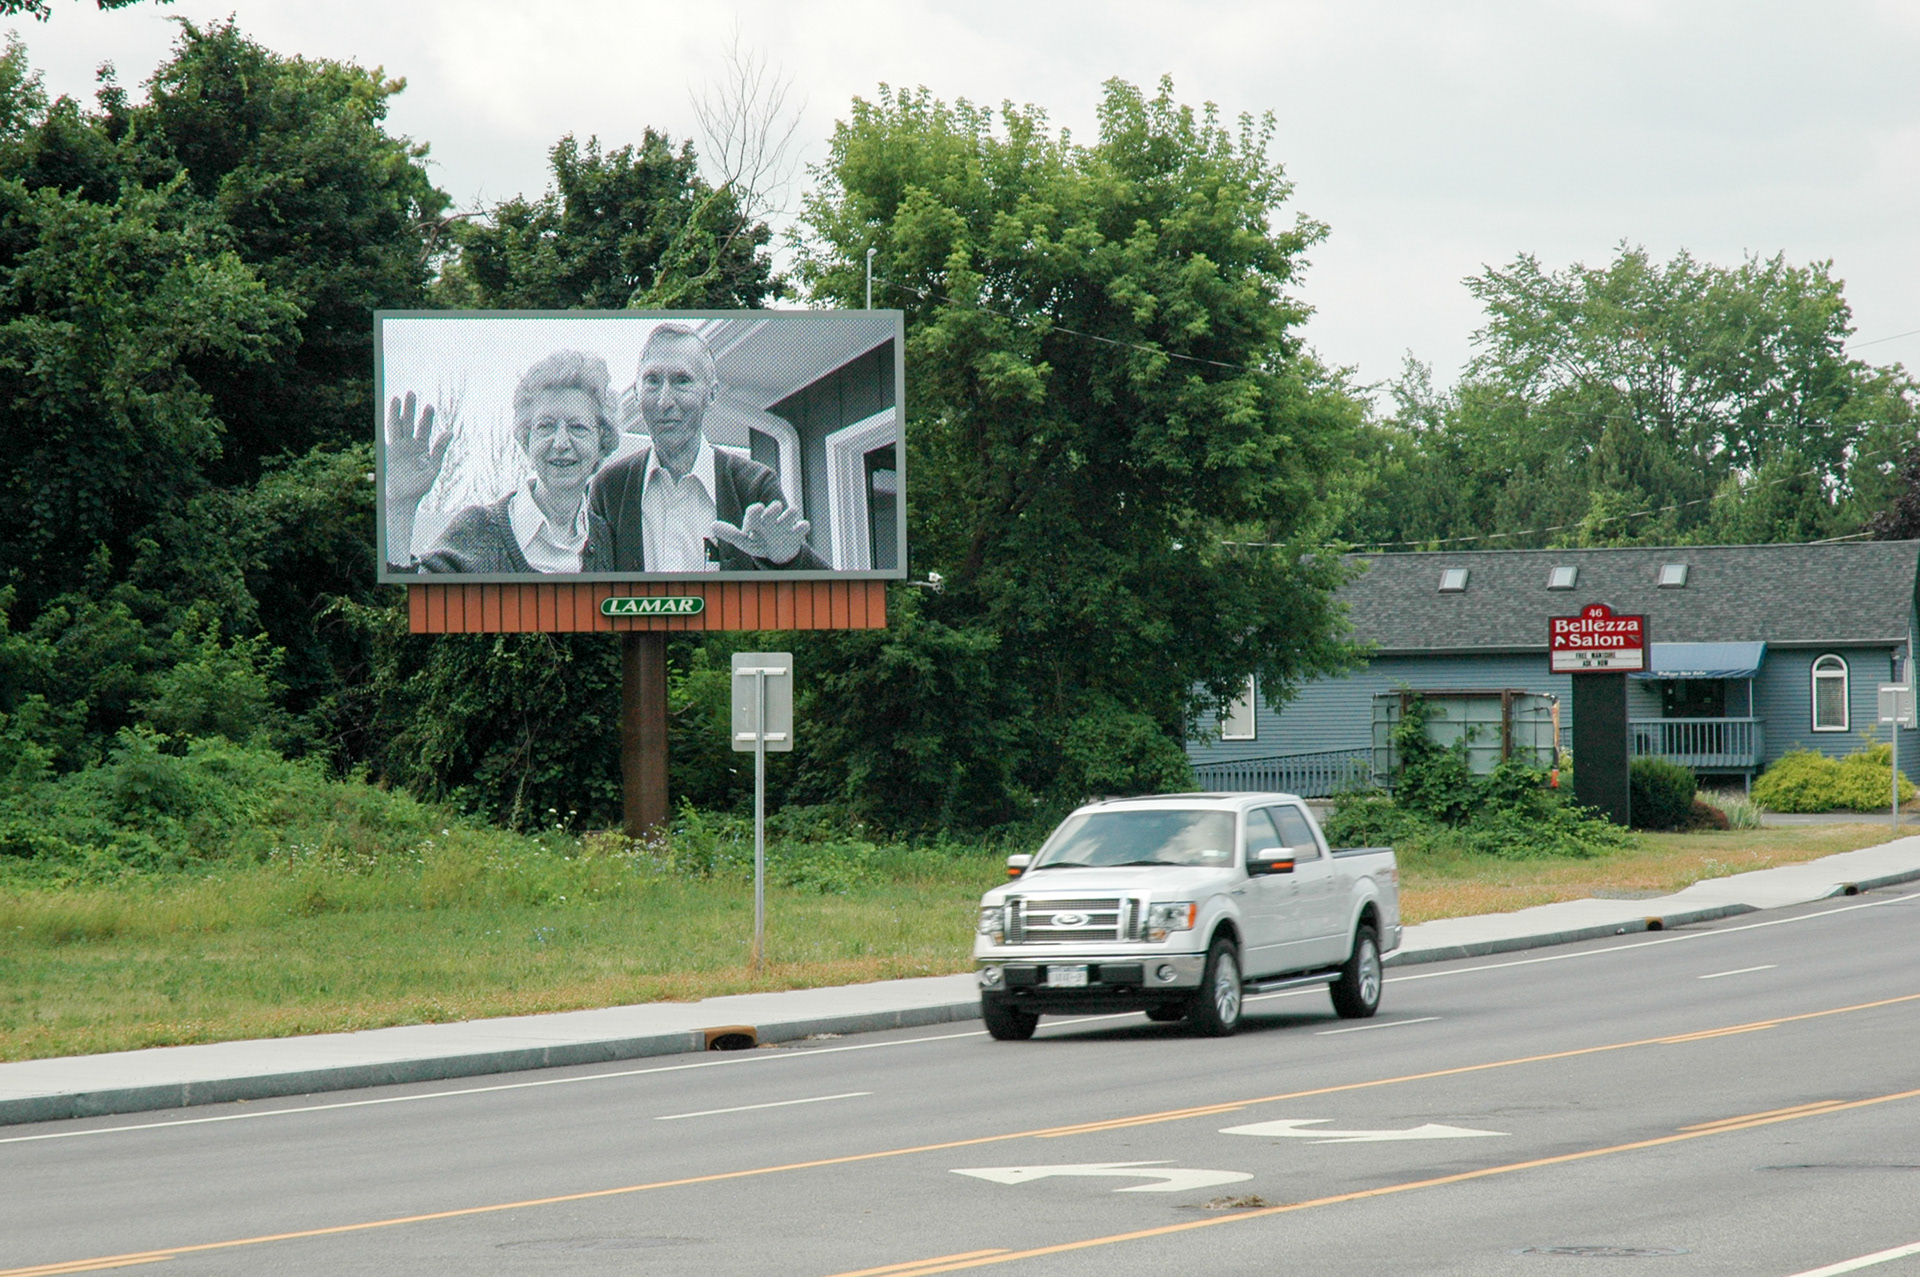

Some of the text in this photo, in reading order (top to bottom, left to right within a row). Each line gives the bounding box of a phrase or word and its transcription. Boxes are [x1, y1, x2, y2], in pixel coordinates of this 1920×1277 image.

[610, 599, 693, 612] LAMAR
[1589, 608, 1603, 618] 46
[1569, 634, 1625, 647] Salon
